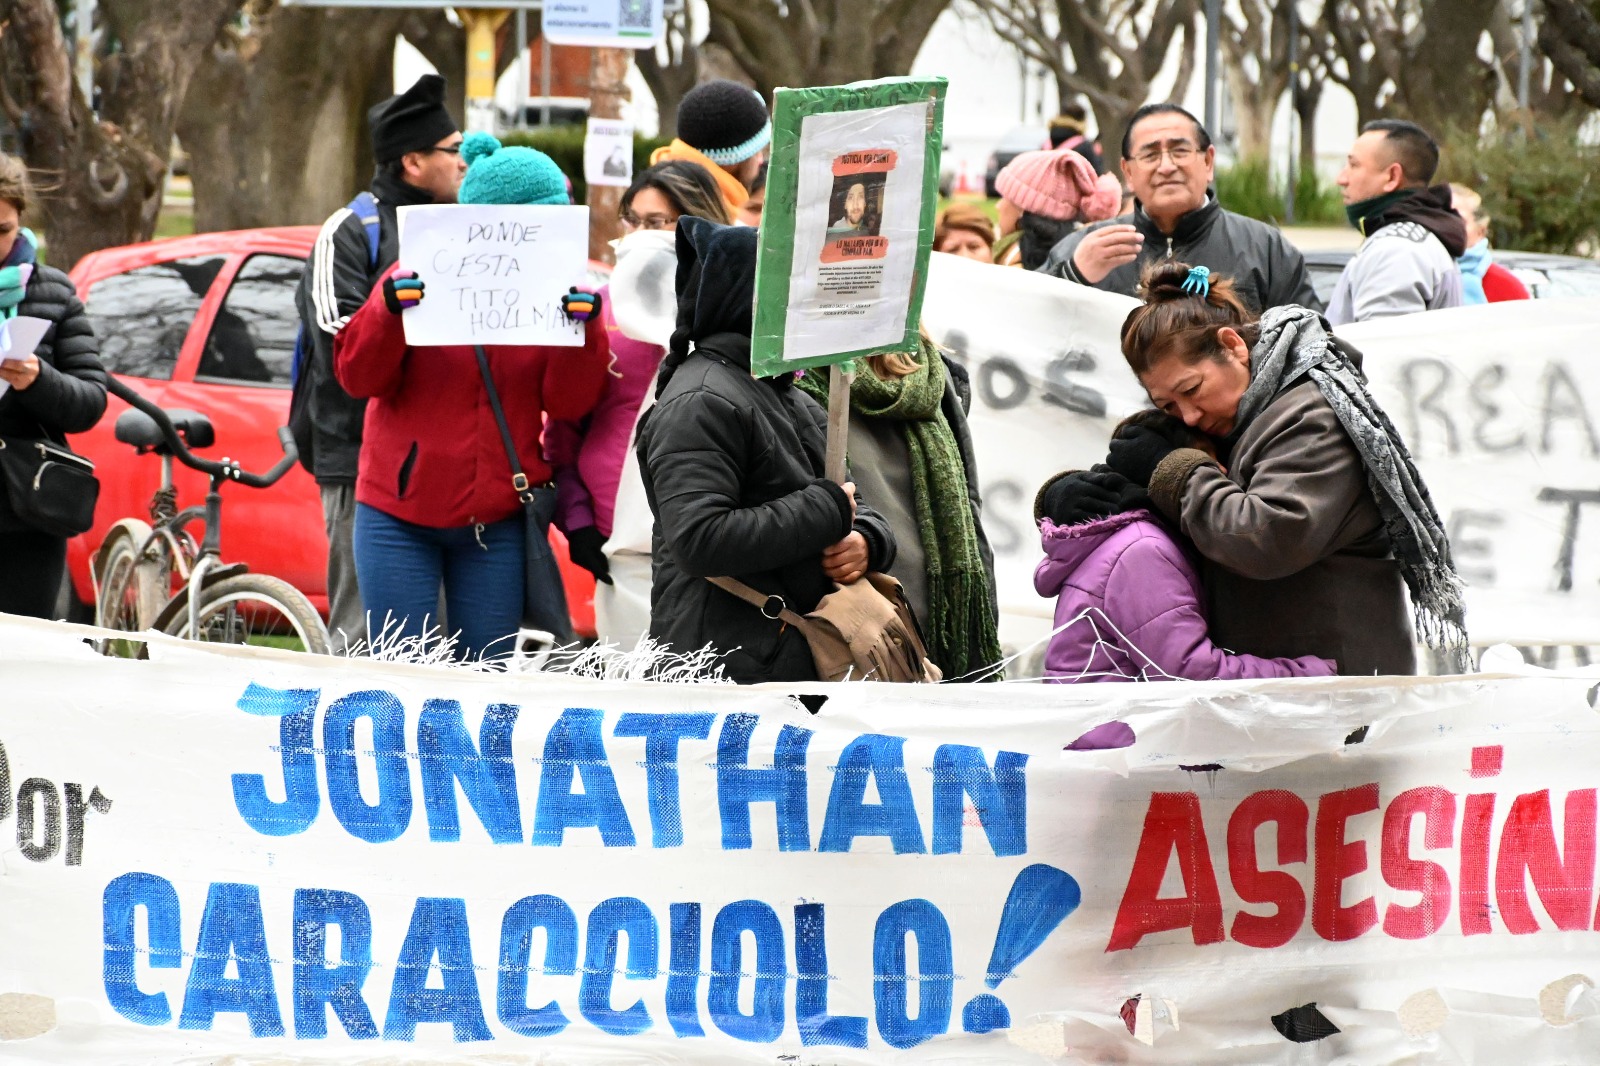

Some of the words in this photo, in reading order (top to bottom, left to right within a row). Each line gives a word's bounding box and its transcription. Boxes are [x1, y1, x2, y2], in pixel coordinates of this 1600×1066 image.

[841, 154, 862, 164] JUSTICIA
[467, 221, 543, 246] DONDE
[451, 287, 520, 310] TITO
[0, 738, 113, 867] or
[231, 681, 1029, 857] JONATHAN
[102, 864, 1081, 1050] CARACCIOLO!
